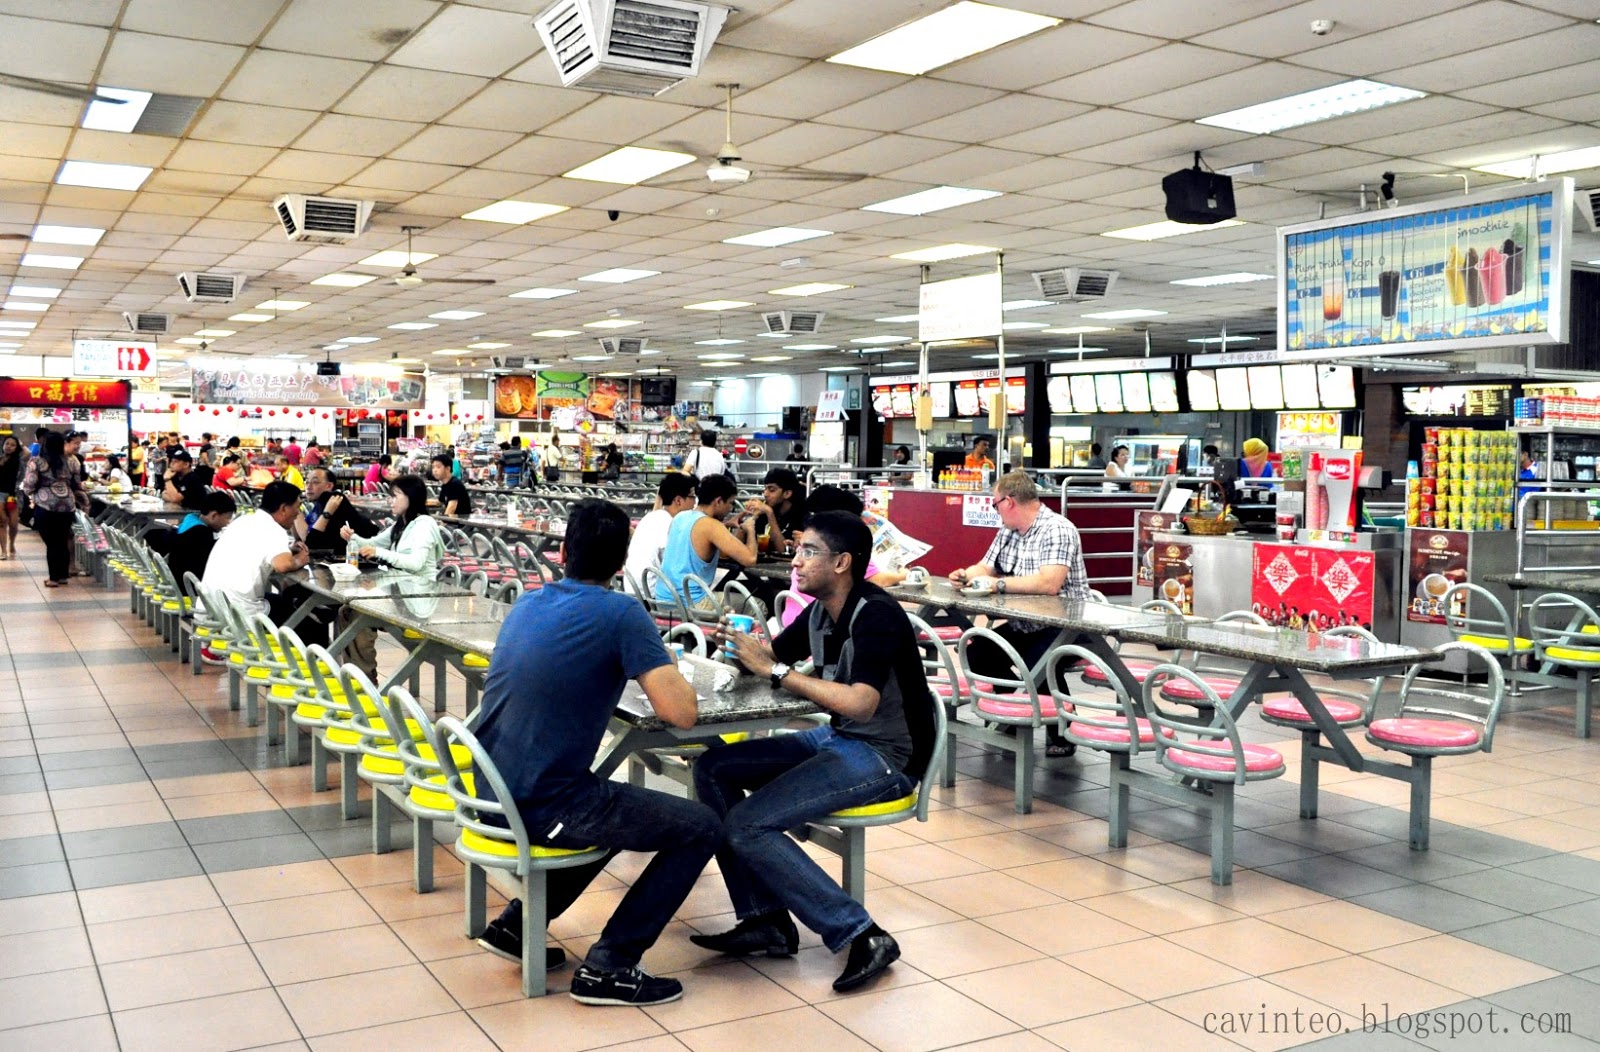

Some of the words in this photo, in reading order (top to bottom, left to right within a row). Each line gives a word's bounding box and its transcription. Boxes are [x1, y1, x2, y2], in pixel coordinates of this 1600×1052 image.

[1352, 256, 1374, 272] Kopi
[220, 372, 313, 389] 马来西亚土产
